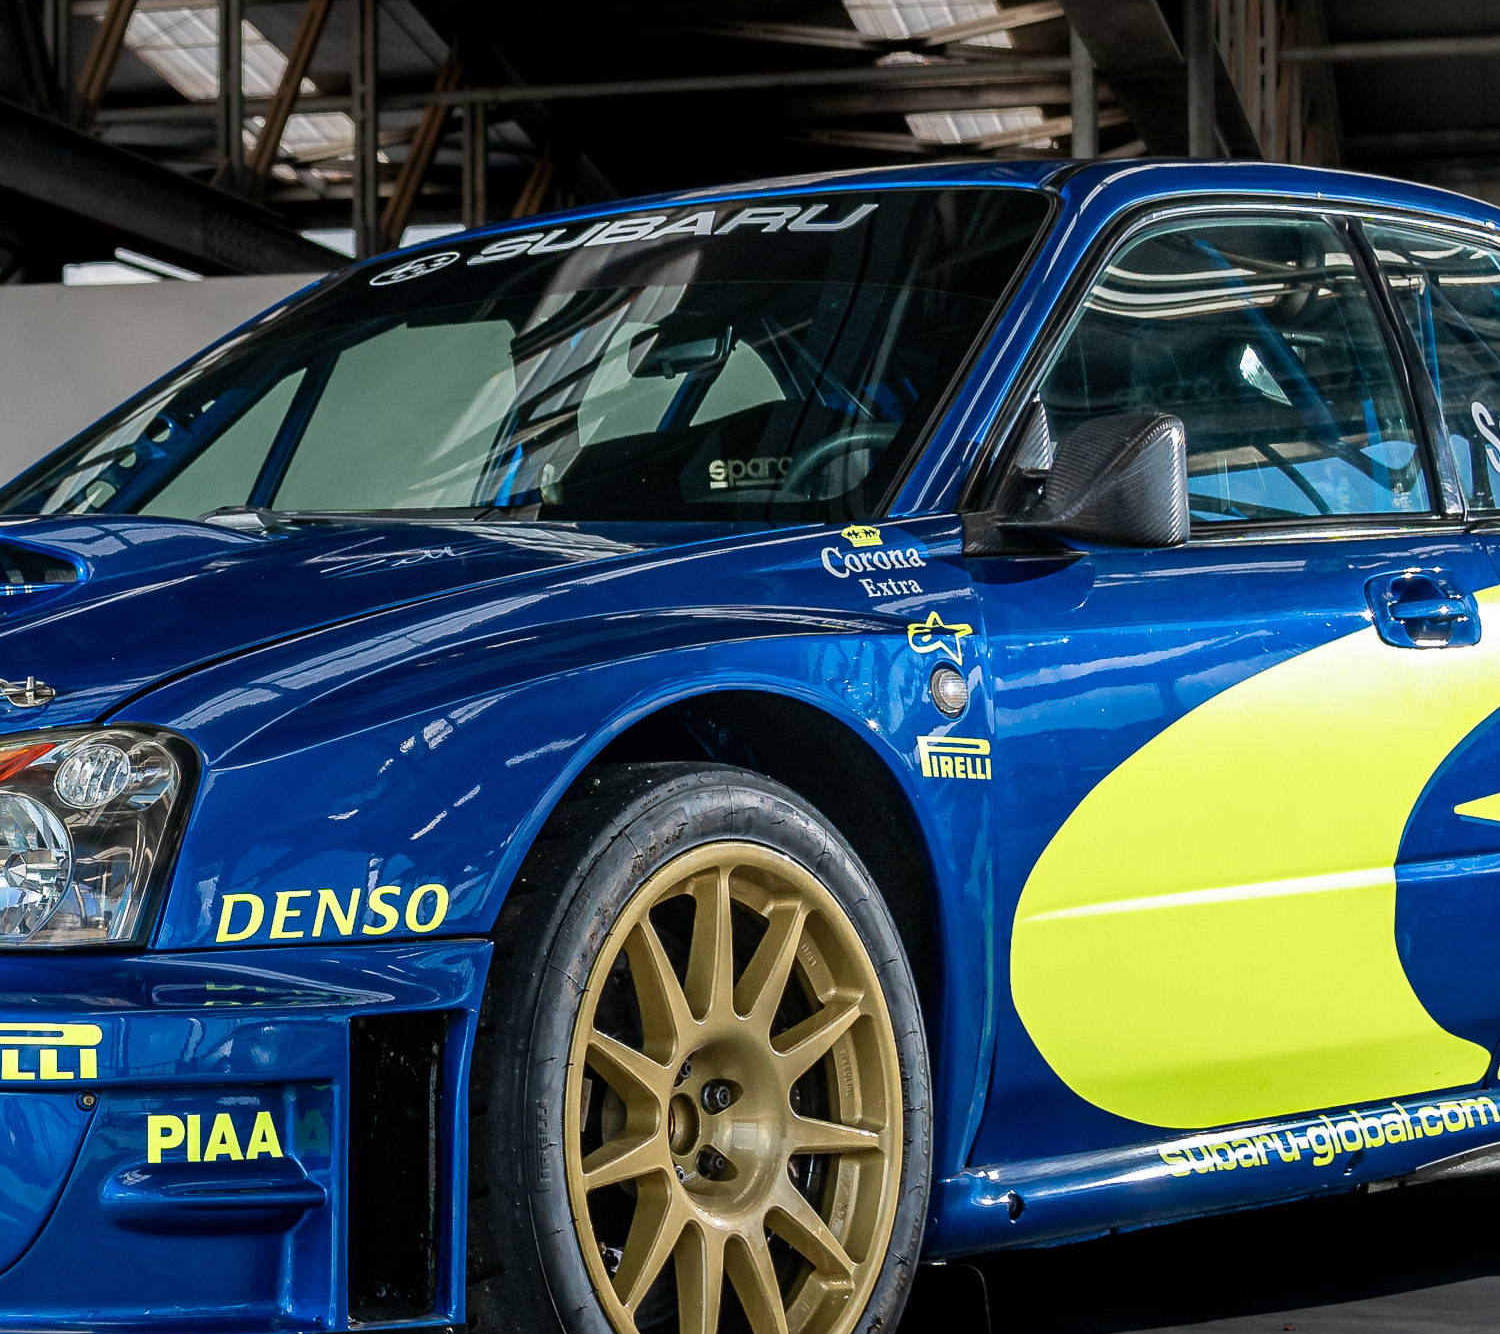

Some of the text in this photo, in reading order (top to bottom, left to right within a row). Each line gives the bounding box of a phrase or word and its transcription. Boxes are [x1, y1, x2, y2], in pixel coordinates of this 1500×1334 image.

[466, 204, 879, 266] SUBARU
[708, 456, 793, 488] sparc
[821, 546, 927, 578] Corona
[858, 577, 924, 598] Extra
[916, 735, 992, 780] PIRELLI
[215, 882, 449, 944] DENSO
[147, 1111, 284, 1164] PIAA
[1157, 1096, 1500, 1178] subaru-global.com
